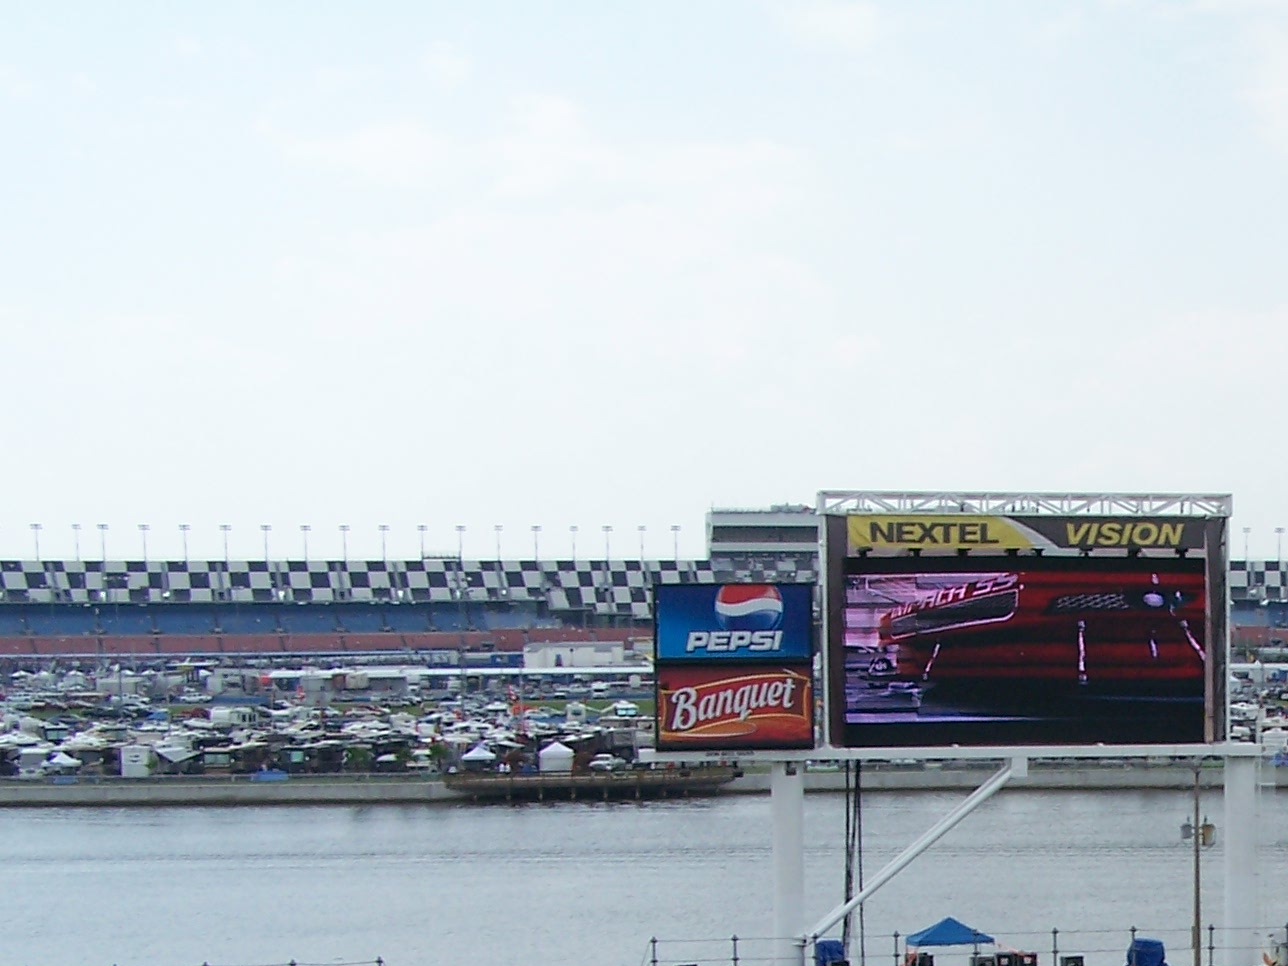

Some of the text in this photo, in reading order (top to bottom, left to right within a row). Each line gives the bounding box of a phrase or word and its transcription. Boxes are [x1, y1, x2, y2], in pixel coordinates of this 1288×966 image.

[869, 521, 1185, 546] NEXTEL VISION
[685, 630, 784, 652] PEPSI
[671, 677, 796, 731] Banquet
